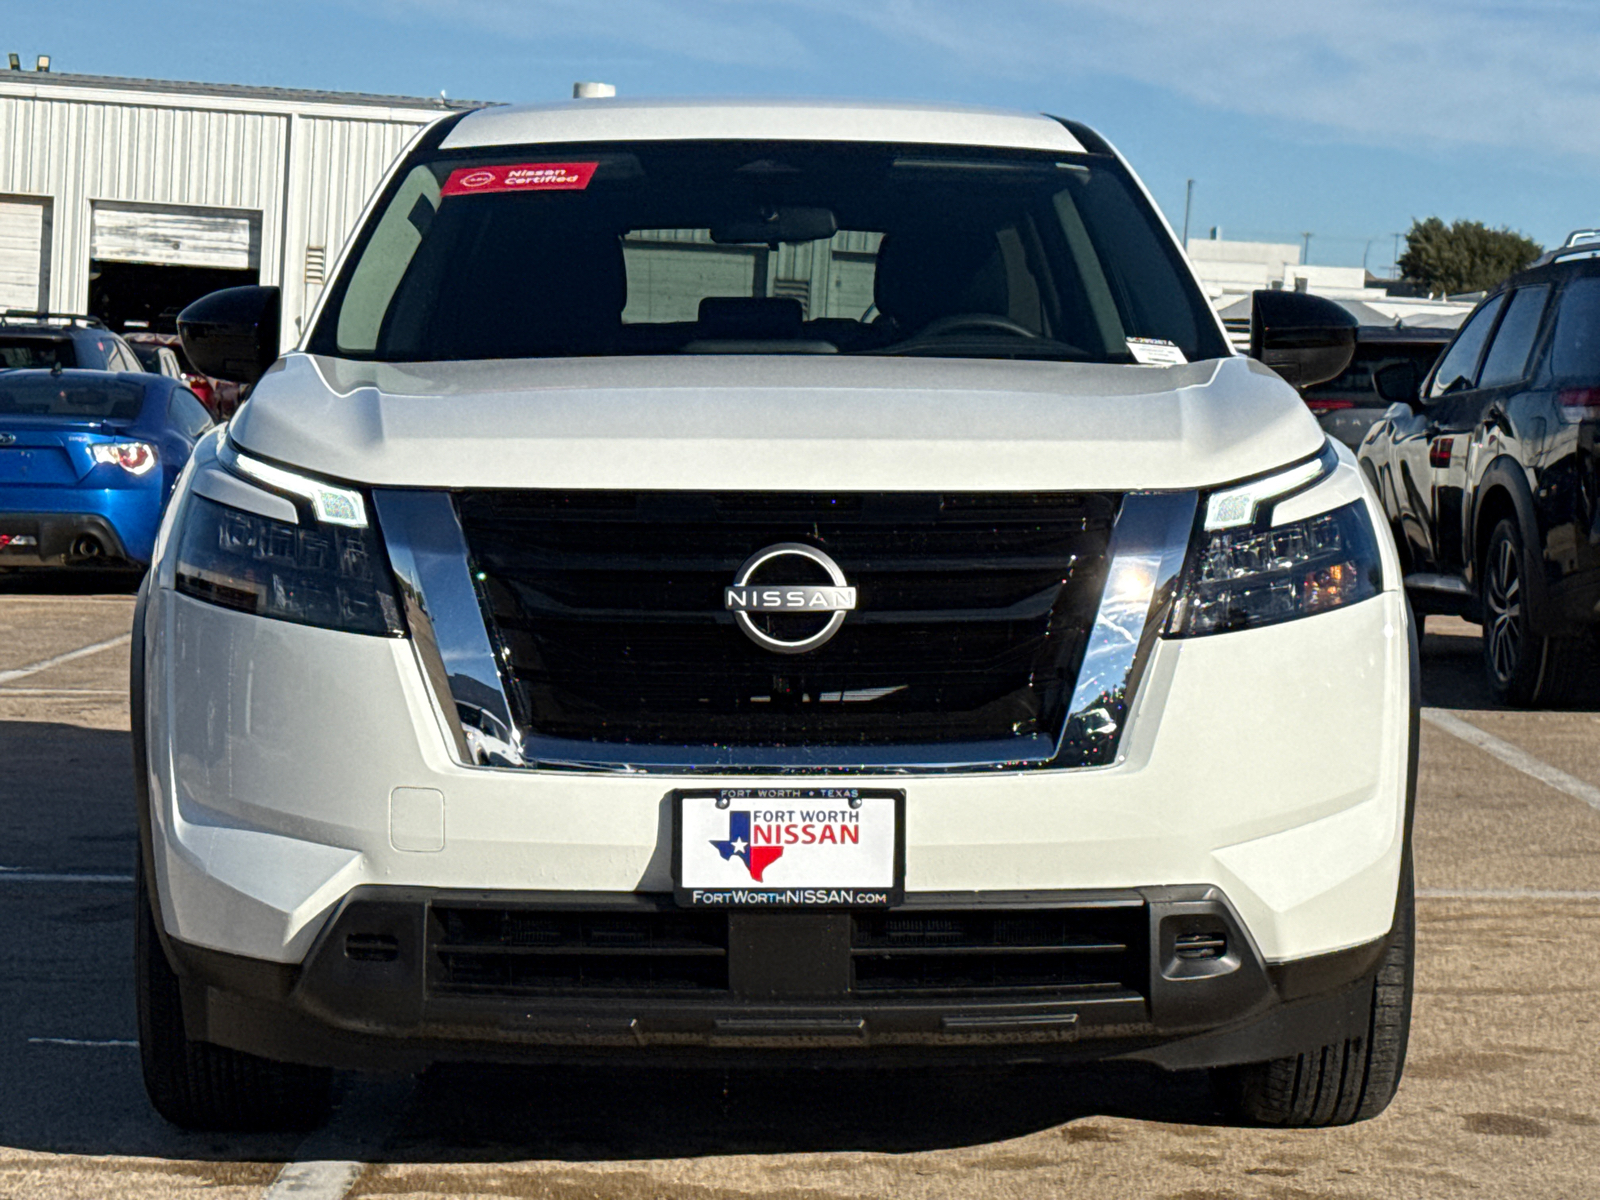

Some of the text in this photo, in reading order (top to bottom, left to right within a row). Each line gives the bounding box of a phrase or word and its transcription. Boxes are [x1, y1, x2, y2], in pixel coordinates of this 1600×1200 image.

[508, 169, 566, 177] Nissan
[504, 174, 579, 185] Certified
[727, 590, 853, 607] NISSAN
[721, 789, 859, 798] FORT WORTH TEXAS
[753, 810, 859, 823] FORT WORTH
[753, 824, 859, 845] NISSAN
